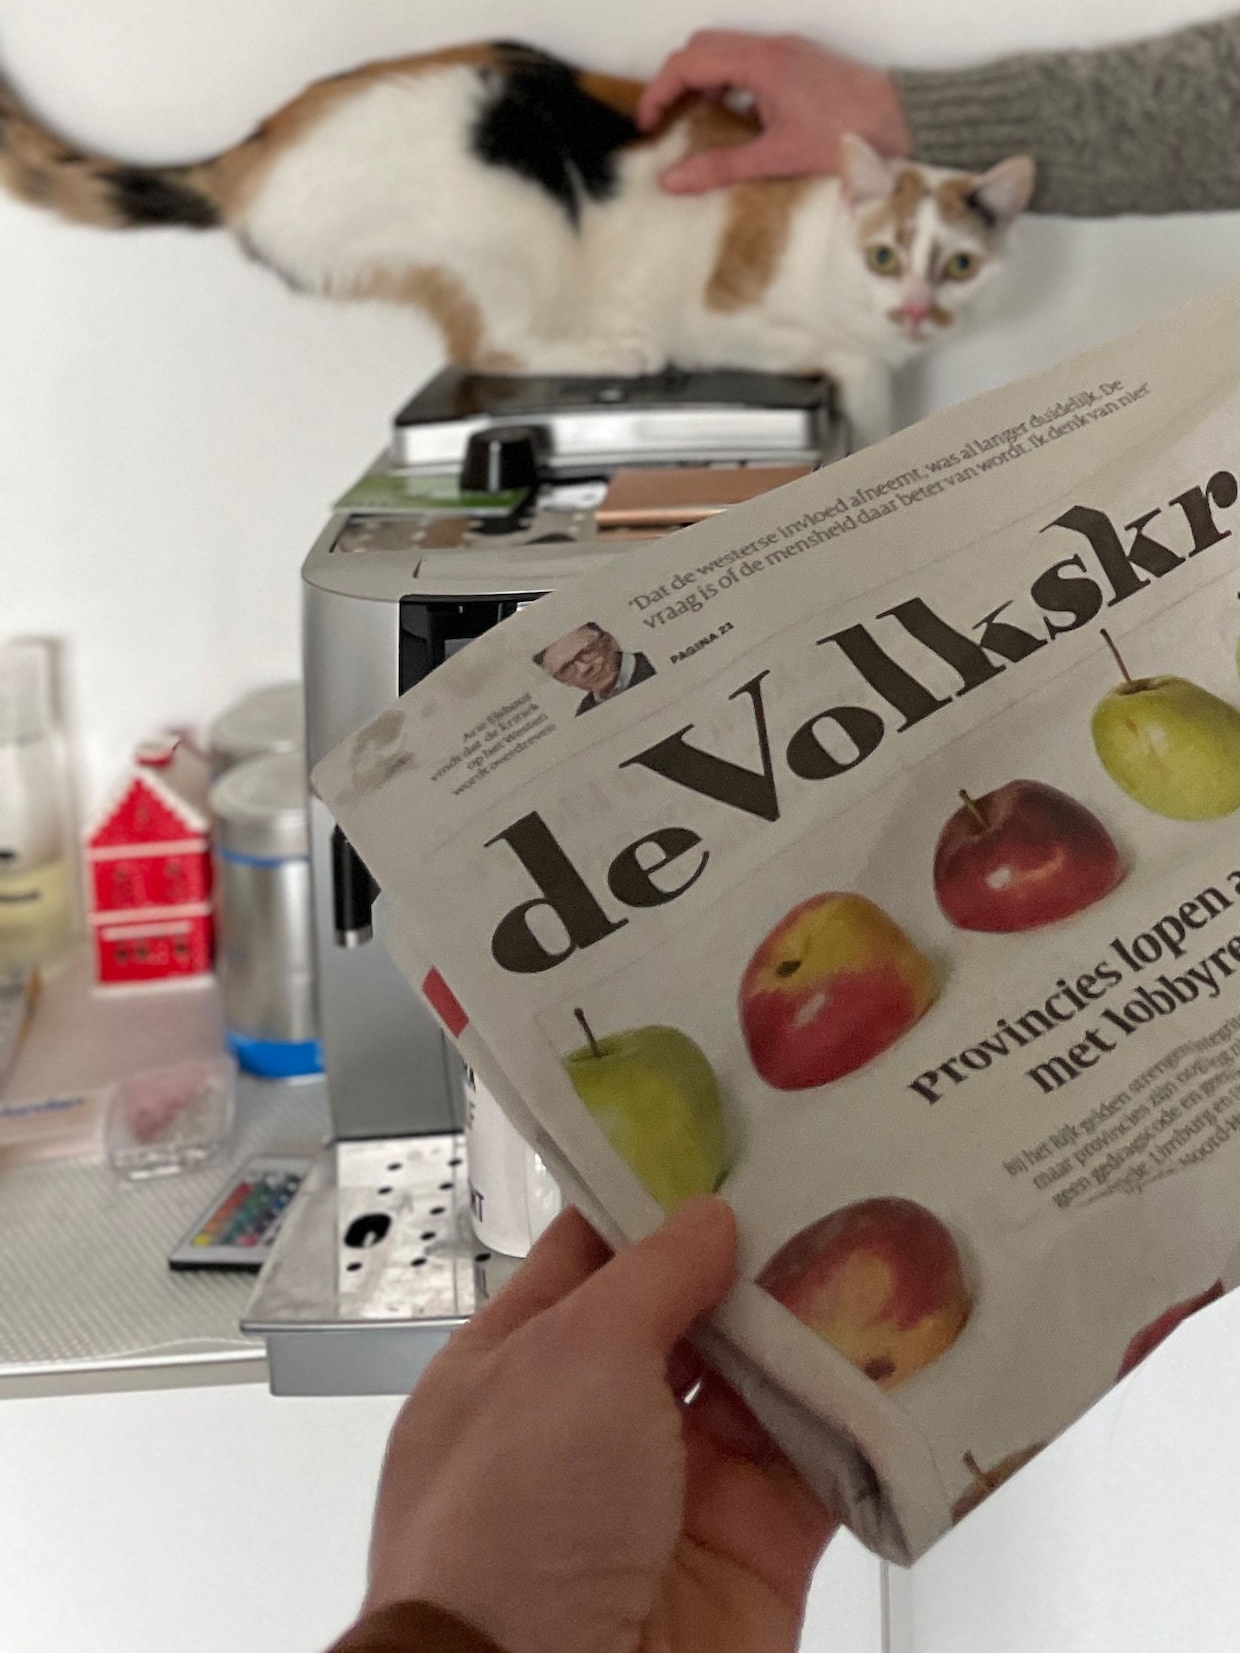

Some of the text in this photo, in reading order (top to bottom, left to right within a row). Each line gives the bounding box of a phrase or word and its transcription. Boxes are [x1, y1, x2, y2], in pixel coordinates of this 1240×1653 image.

[642, 592, 703, 628] vraag
[696, 583, 719, 601] is
[717, 566, 740, 589] of
[739, 559, 765, 577] de
[764, 515, 857, 565] mensheid
[856, 499, 898, 524] daar
[894, 480, 945, 506] beter
[941, 466, 979, 486] van
[1027, 432, 1049, 449] Ik
[1046, 413, 1090, 440] denk
[1086, 398, 1120, 421] van
[669, 571, 697, 590] de
[695, 532, 778, 575] westerse
[777, 497, 848, 538] invloed
[848, 467, 929, 507] afneemt,
[924, 452, 961, 473] was
[959, 442, 978, 460] al
[972, 422, 1028, 453] langer
[1098, 379, 1124, 396] De
[669, 621, 734, 664] PAGINA 23
[430, 754, 462, 781] vindt
[461, 739, 483, 758] dat
[483, 728, 500, 742] de
[451, 723, 556, 795] wordt overdreven
[466, 755, 484, 770] op
[480, 739, 505, 759] het
[909, 962, 1121, 1103] Provincies
[1109, 887, 1232, 972] lopen
[1025, 1029, 1116, 1093] met
[1001, 1154, 1028, 1178] Bij
[1021, 1141, 1053, 1165] het
[1048, 1123, 1081, 1150] Rijk
[1078, 1091, 1131, 1135] gelden
[1032, 1157, 1073, 1190] maar
[1072, 1104, 1150, 1167] provincies
[1147, 1080, 1178, 1107] zijn
[1052, 1176, 1091, 1209] geen
[1178, 1089, 1203, 1110] en
[1148, 1107, 1218, 1165] Limburg
